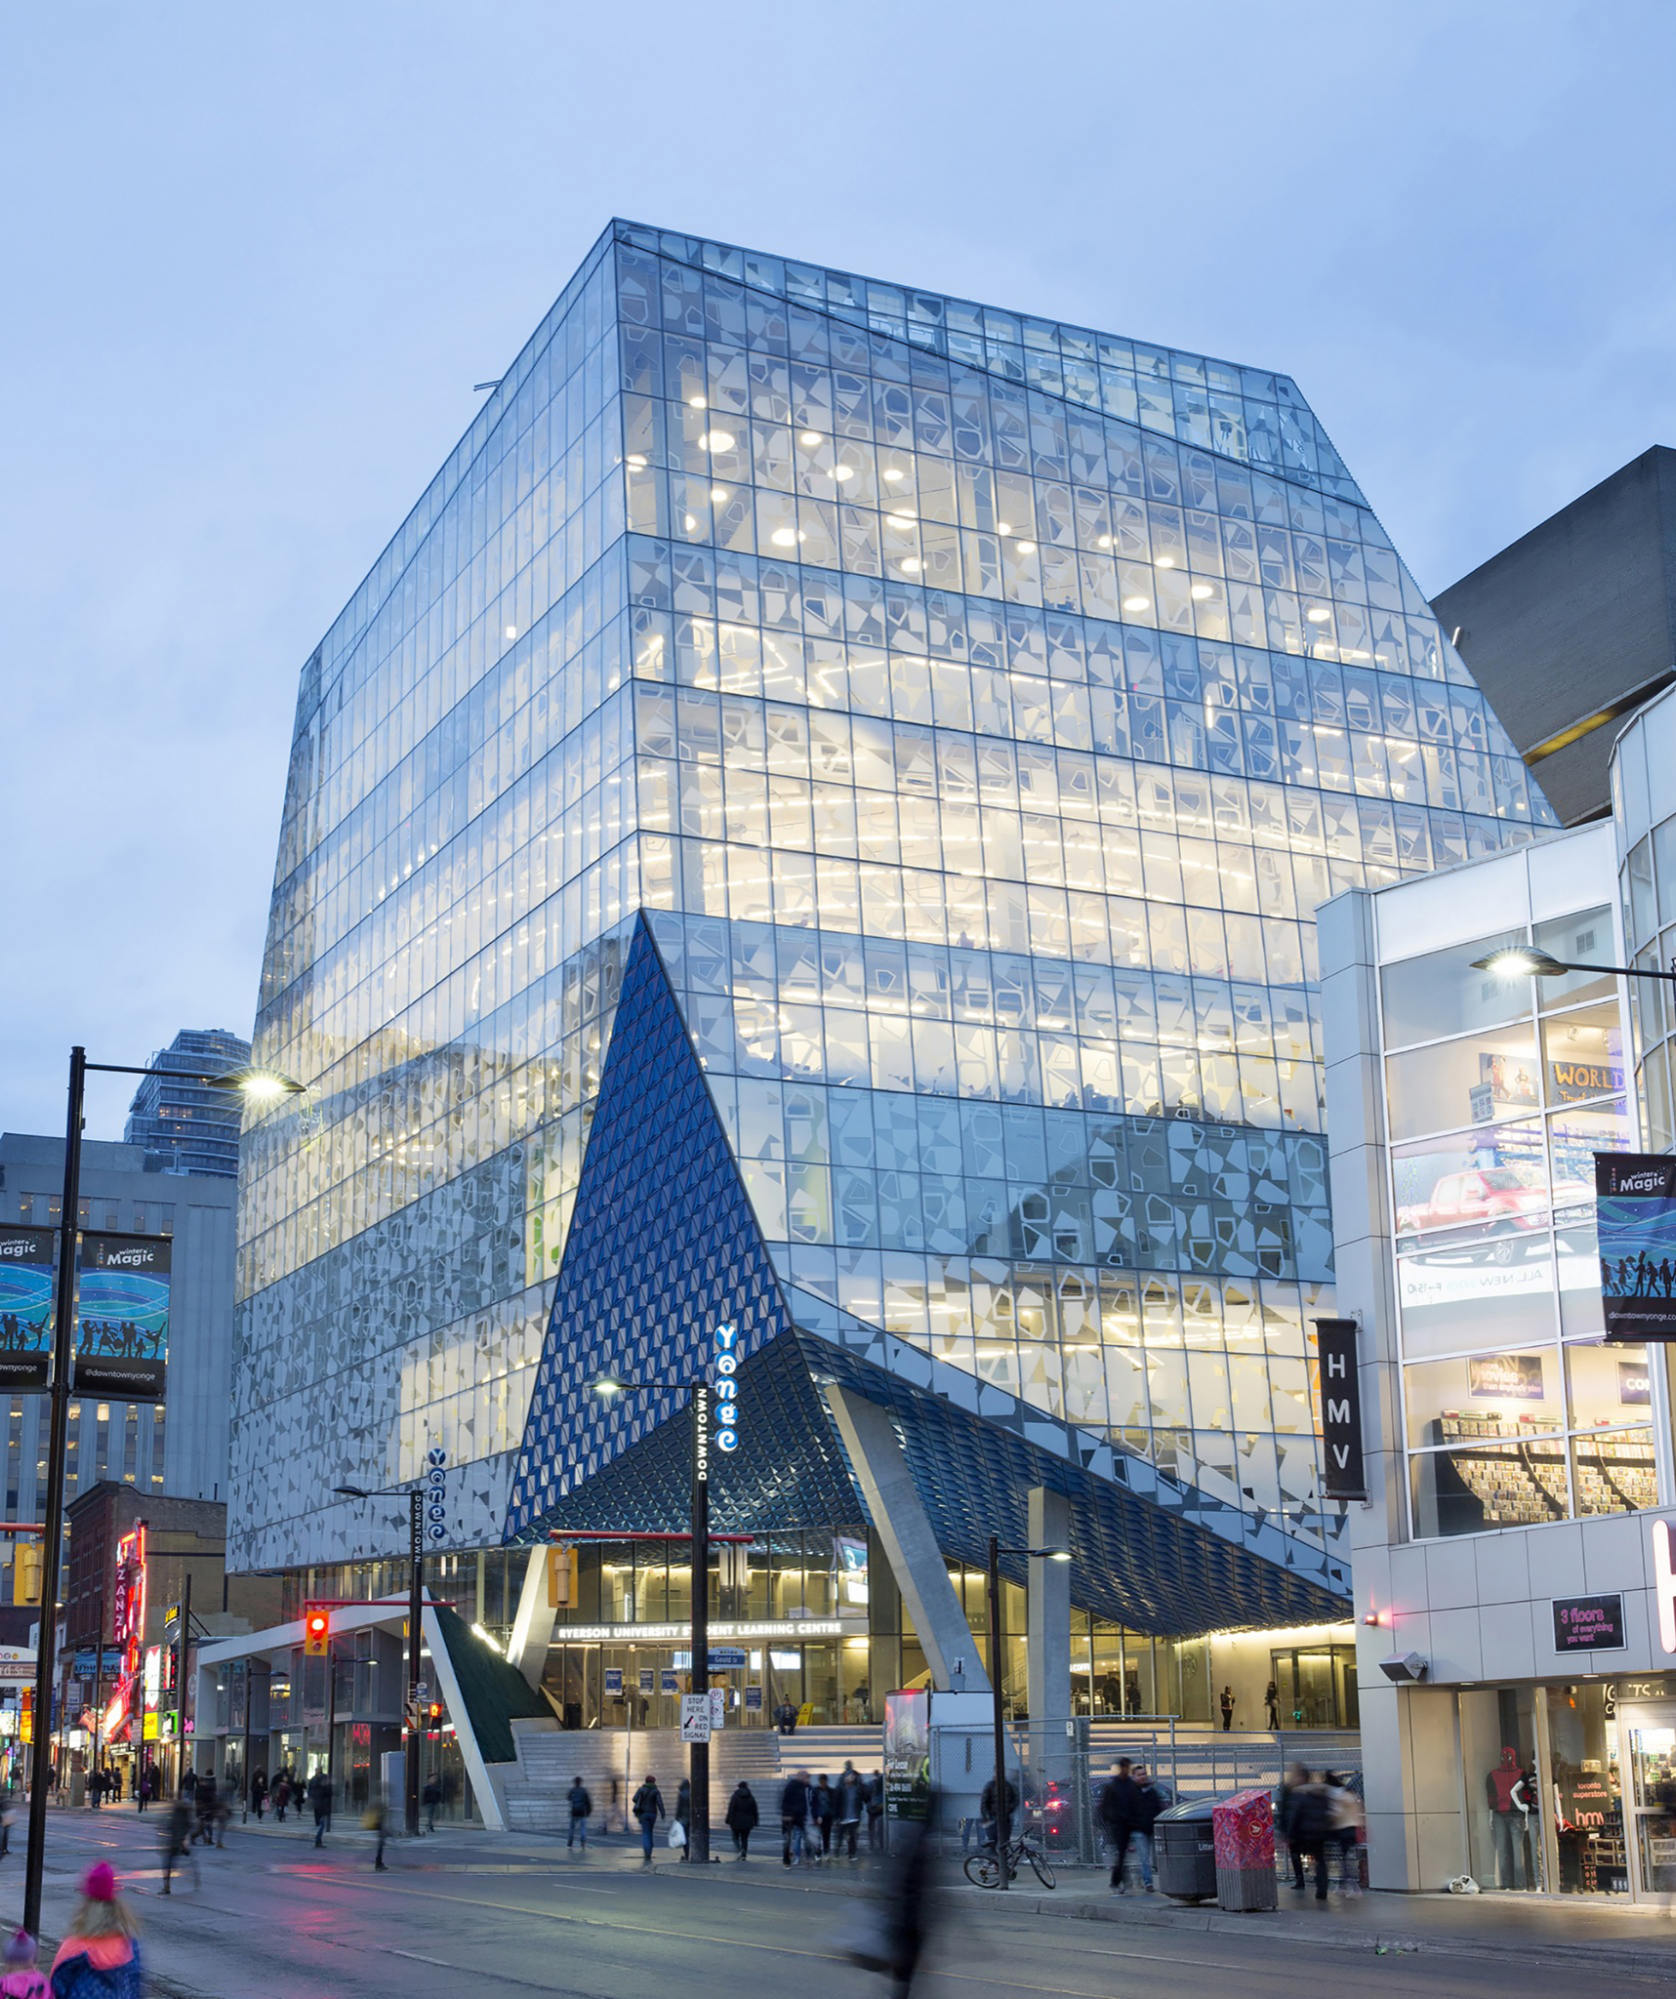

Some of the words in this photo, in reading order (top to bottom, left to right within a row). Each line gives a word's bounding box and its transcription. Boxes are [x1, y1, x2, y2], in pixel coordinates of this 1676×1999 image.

[1554, 1063, 1625, 1089] WORLD
[1620, 1173, 1666, 1192] Magic
[1630, 1172, 1654, 1180] winter
[0, 1239, 26, 1247] winter
[106, 1250, 154, 1266] Magic
[118, 1248, 144, 1256] winter
[85, 1368, 156, 1382] @downtownyonge
[698, 1388, 707, 1481] DOWNTOWN
[414, 1496, 422, 1563] DOWNTOWN
[1561, 1609, 1568, 1624] 3
[1570, 1608, 1604, 1623] floors
[559, 1627, 611, 1638] RYERSON
[613, 1626, 679, 1637] UNIVERSITY
[682, 1625, 733, 1636] SDENT
[738, 1624, 794, 1635] LEARNING
[798, 1623, 842, 1634] CENTRE
[1572, 1625, 1579, 1633] of
[1580, 1623, 1613, 1634] everything
[715, 1656, 731, 1664] Gould
[1573, 1791, 1607, 1799] superstore
